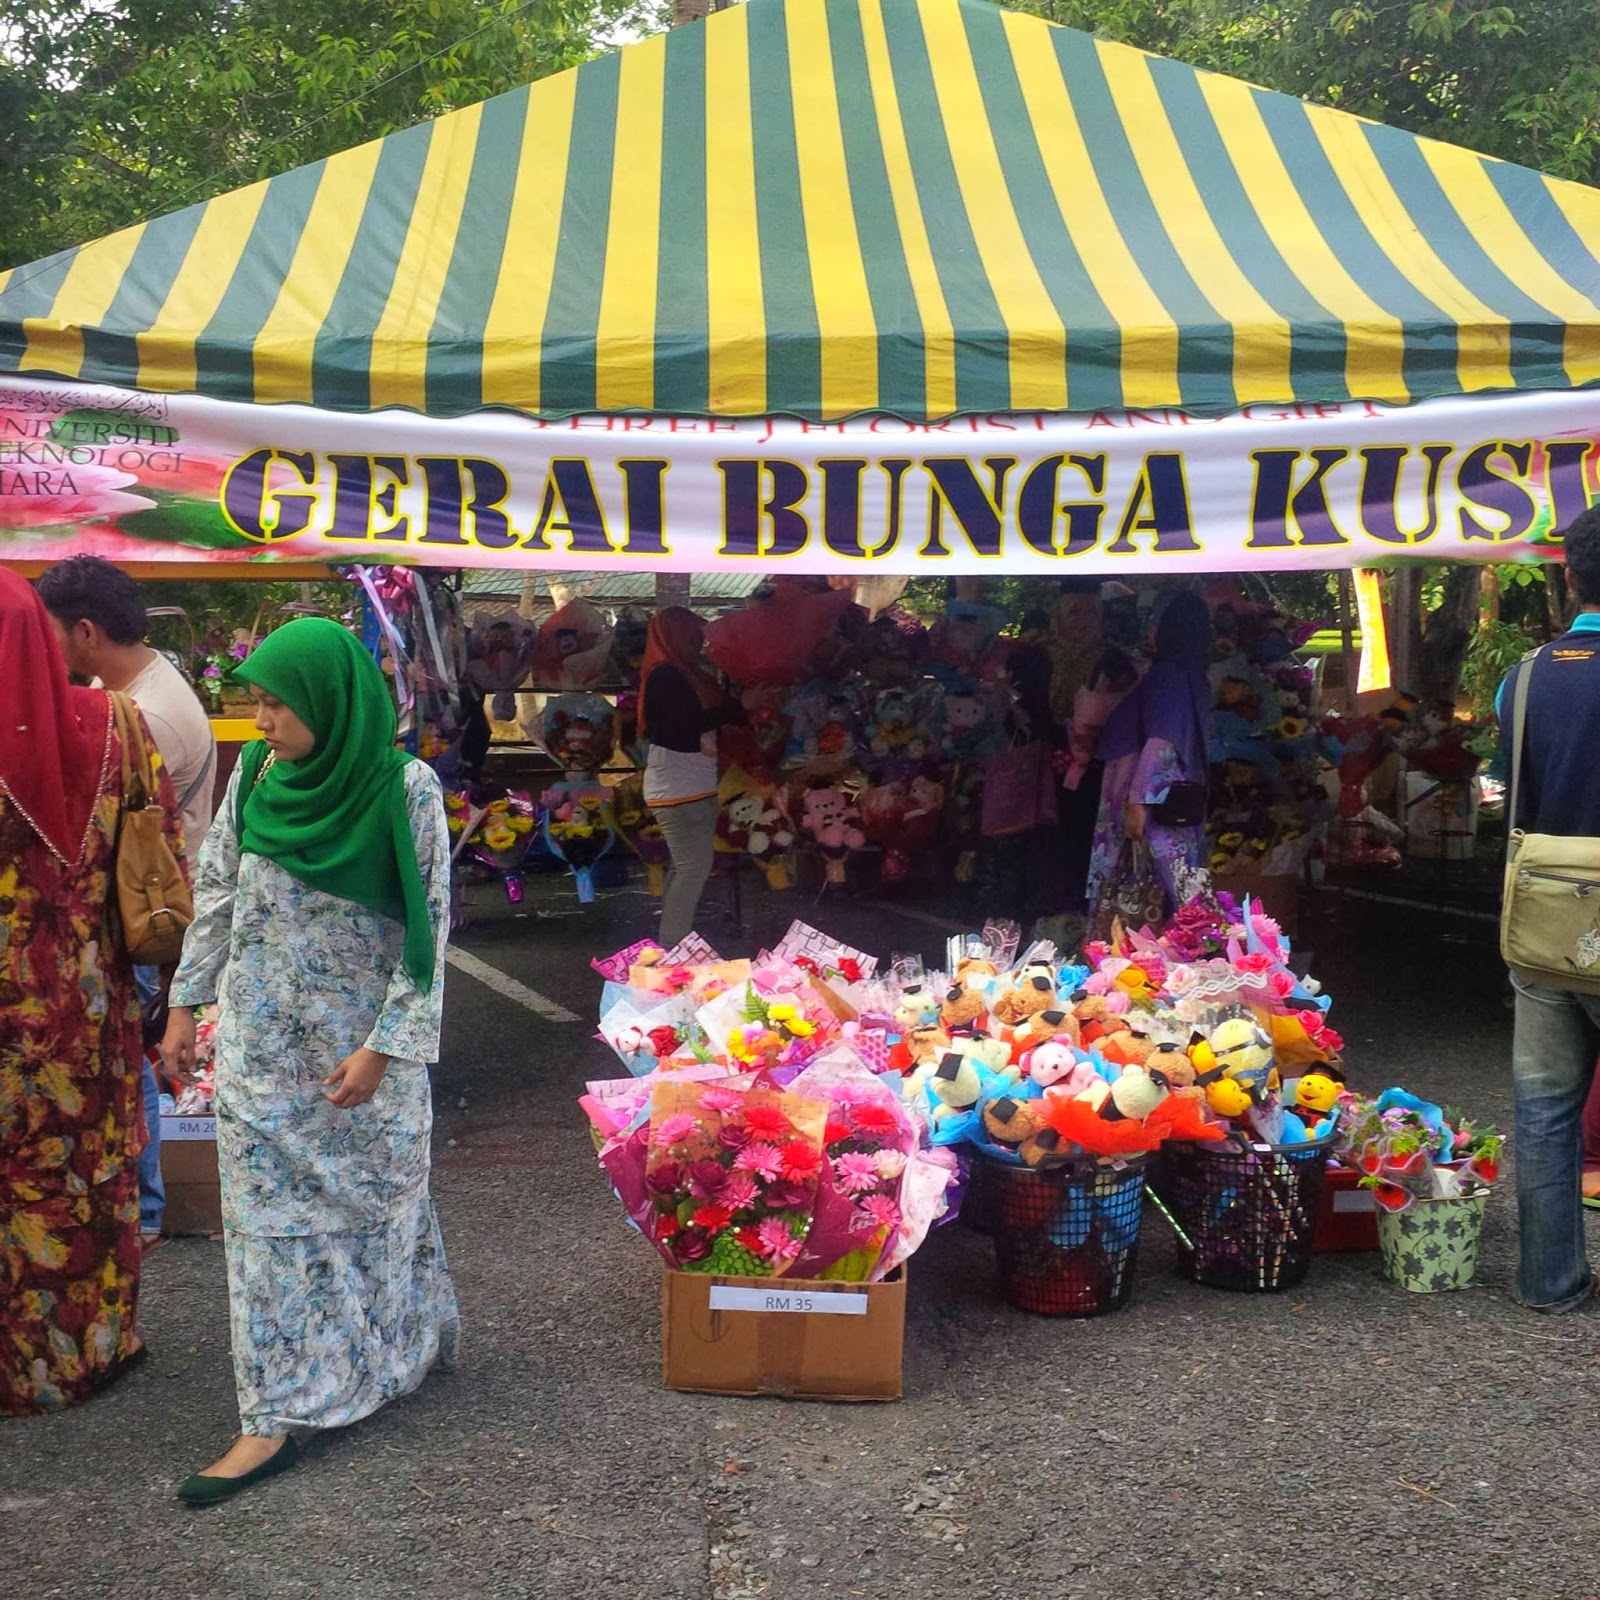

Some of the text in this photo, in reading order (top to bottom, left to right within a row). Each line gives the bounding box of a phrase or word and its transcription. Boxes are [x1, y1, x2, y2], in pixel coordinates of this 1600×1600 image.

[0, 415, 178, 448] NIVERSITI
[219, 438, 1600, 560] GERAI BUNGA KUSI
[179, 1122, 200, 1133] RM
[765, 1296, 813, 1312] RM 35
